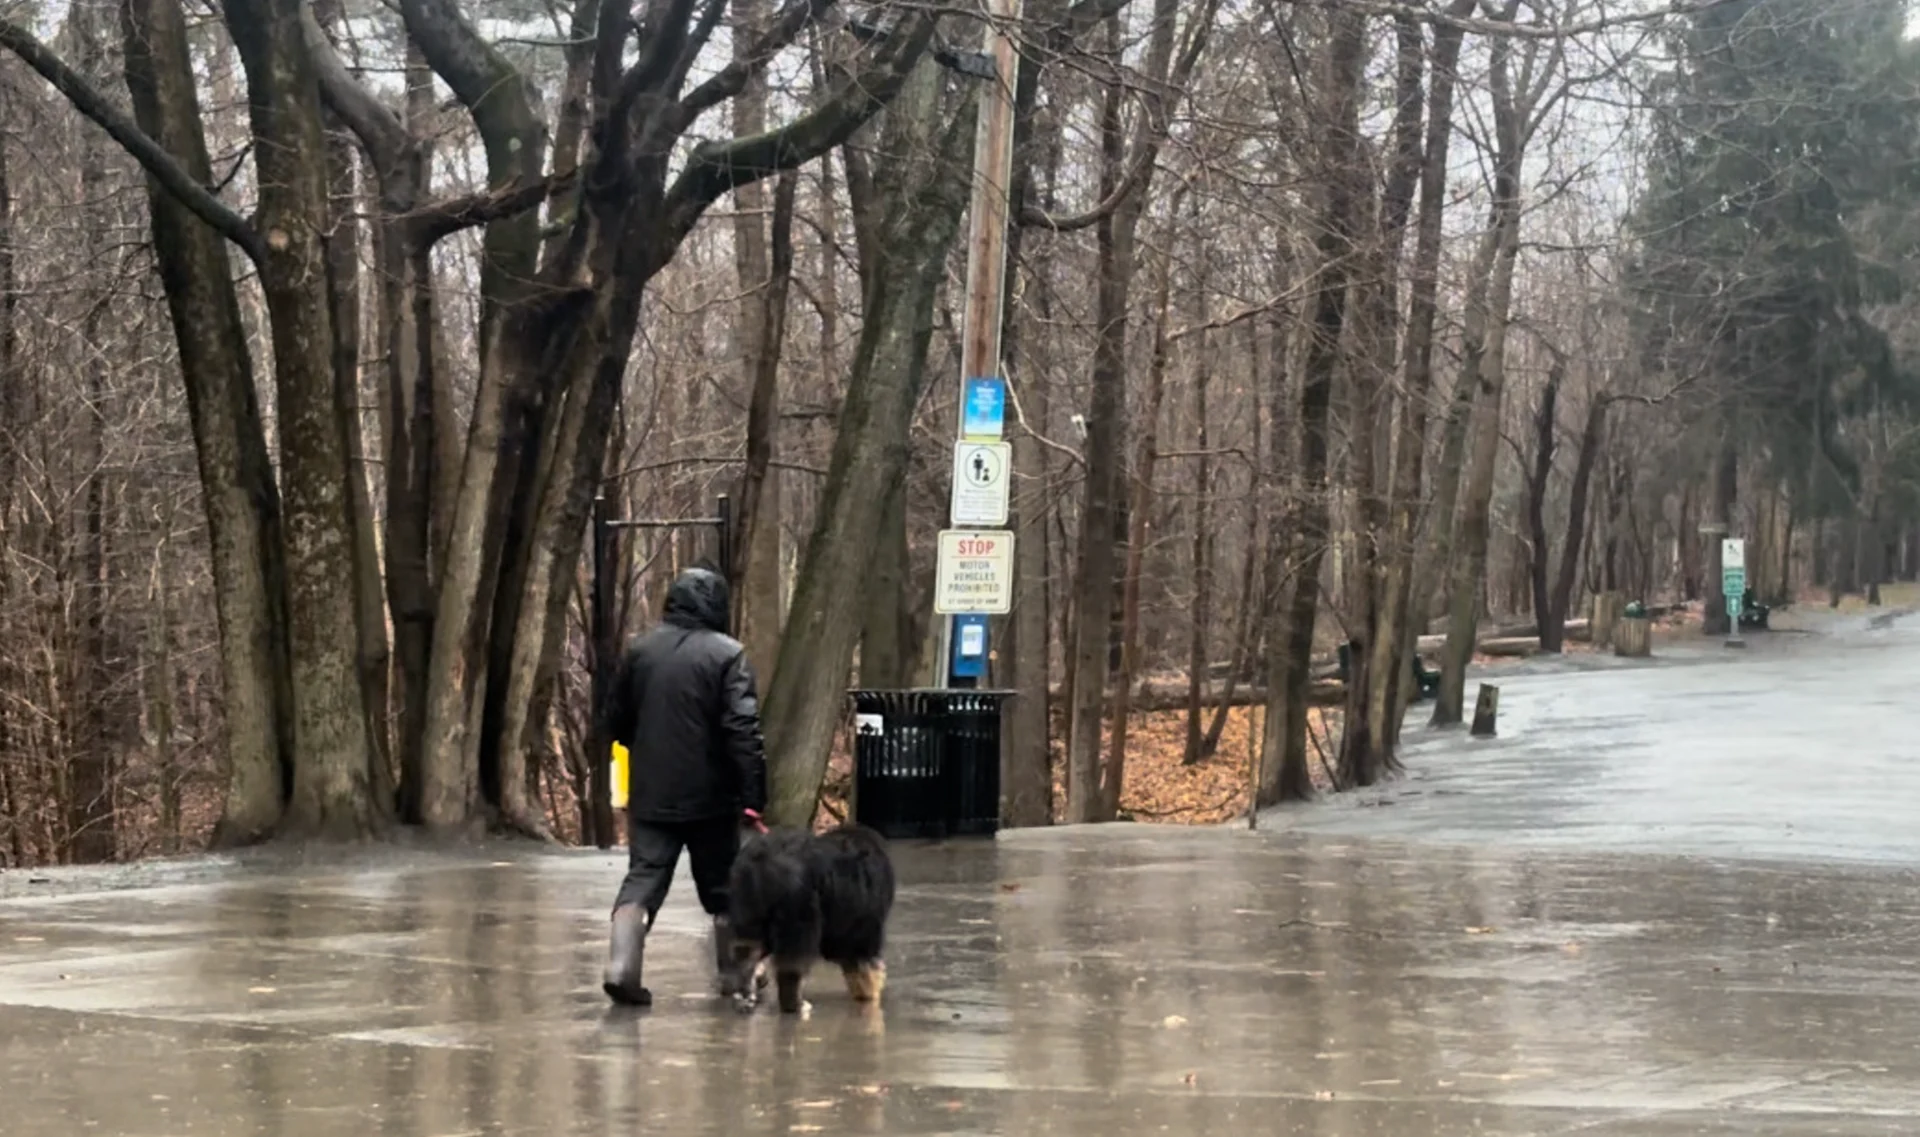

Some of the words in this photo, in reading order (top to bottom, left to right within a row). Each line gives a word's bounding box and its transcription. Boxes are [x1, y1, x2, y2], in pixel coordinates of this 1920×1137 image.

[958, 540, 995, 554] STOP
[959, 561, 990, 570] MOTOR
[954, 573, 996, 581] VEHICLES
[948, 583, 1000, 592] PROHIBITED
